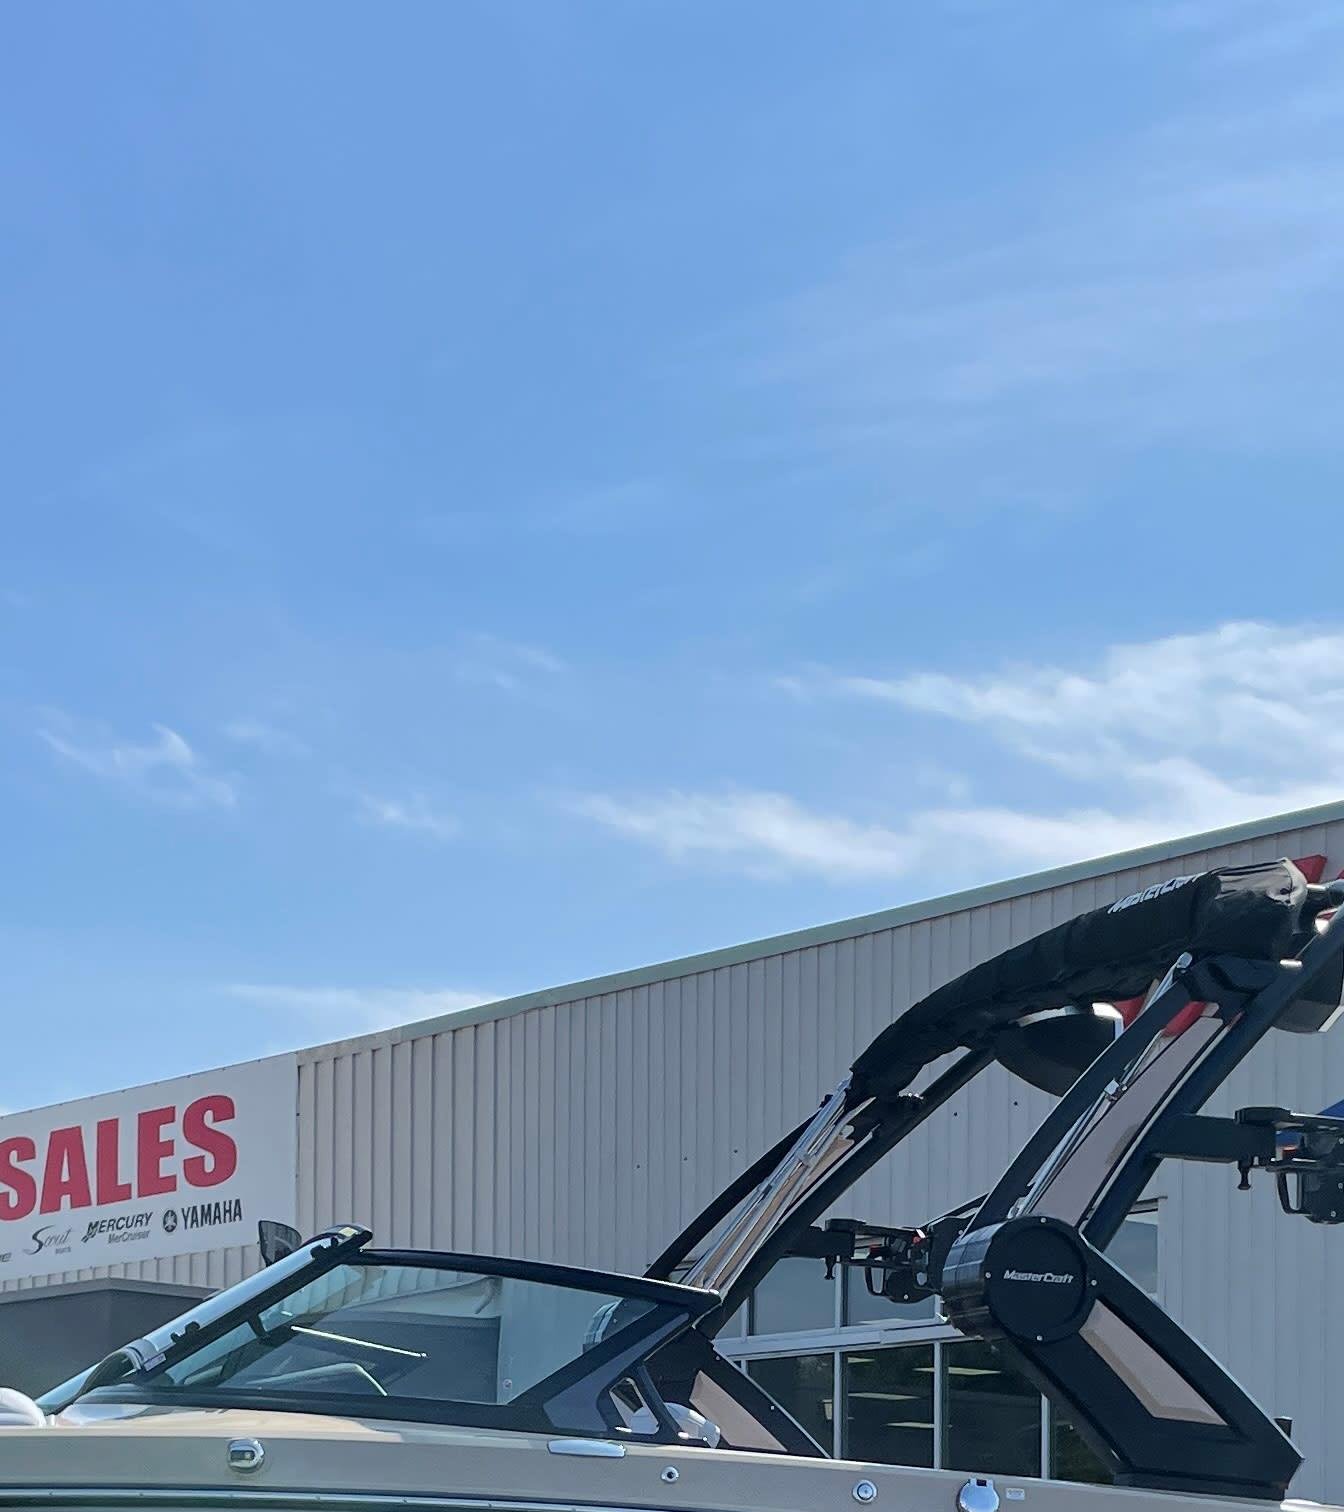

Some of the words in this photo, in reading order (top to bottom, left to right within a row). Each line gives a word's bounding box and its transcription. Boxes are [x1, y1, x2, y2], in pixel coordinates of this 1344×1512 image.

[81, 1212, 153, 1242] MERCURY
[181, 1199, 242, 1230] YAMAHA
[23, 1225, 73, 1255] Scout
[1003, 1269, 1074, 1284] MasterCraft
